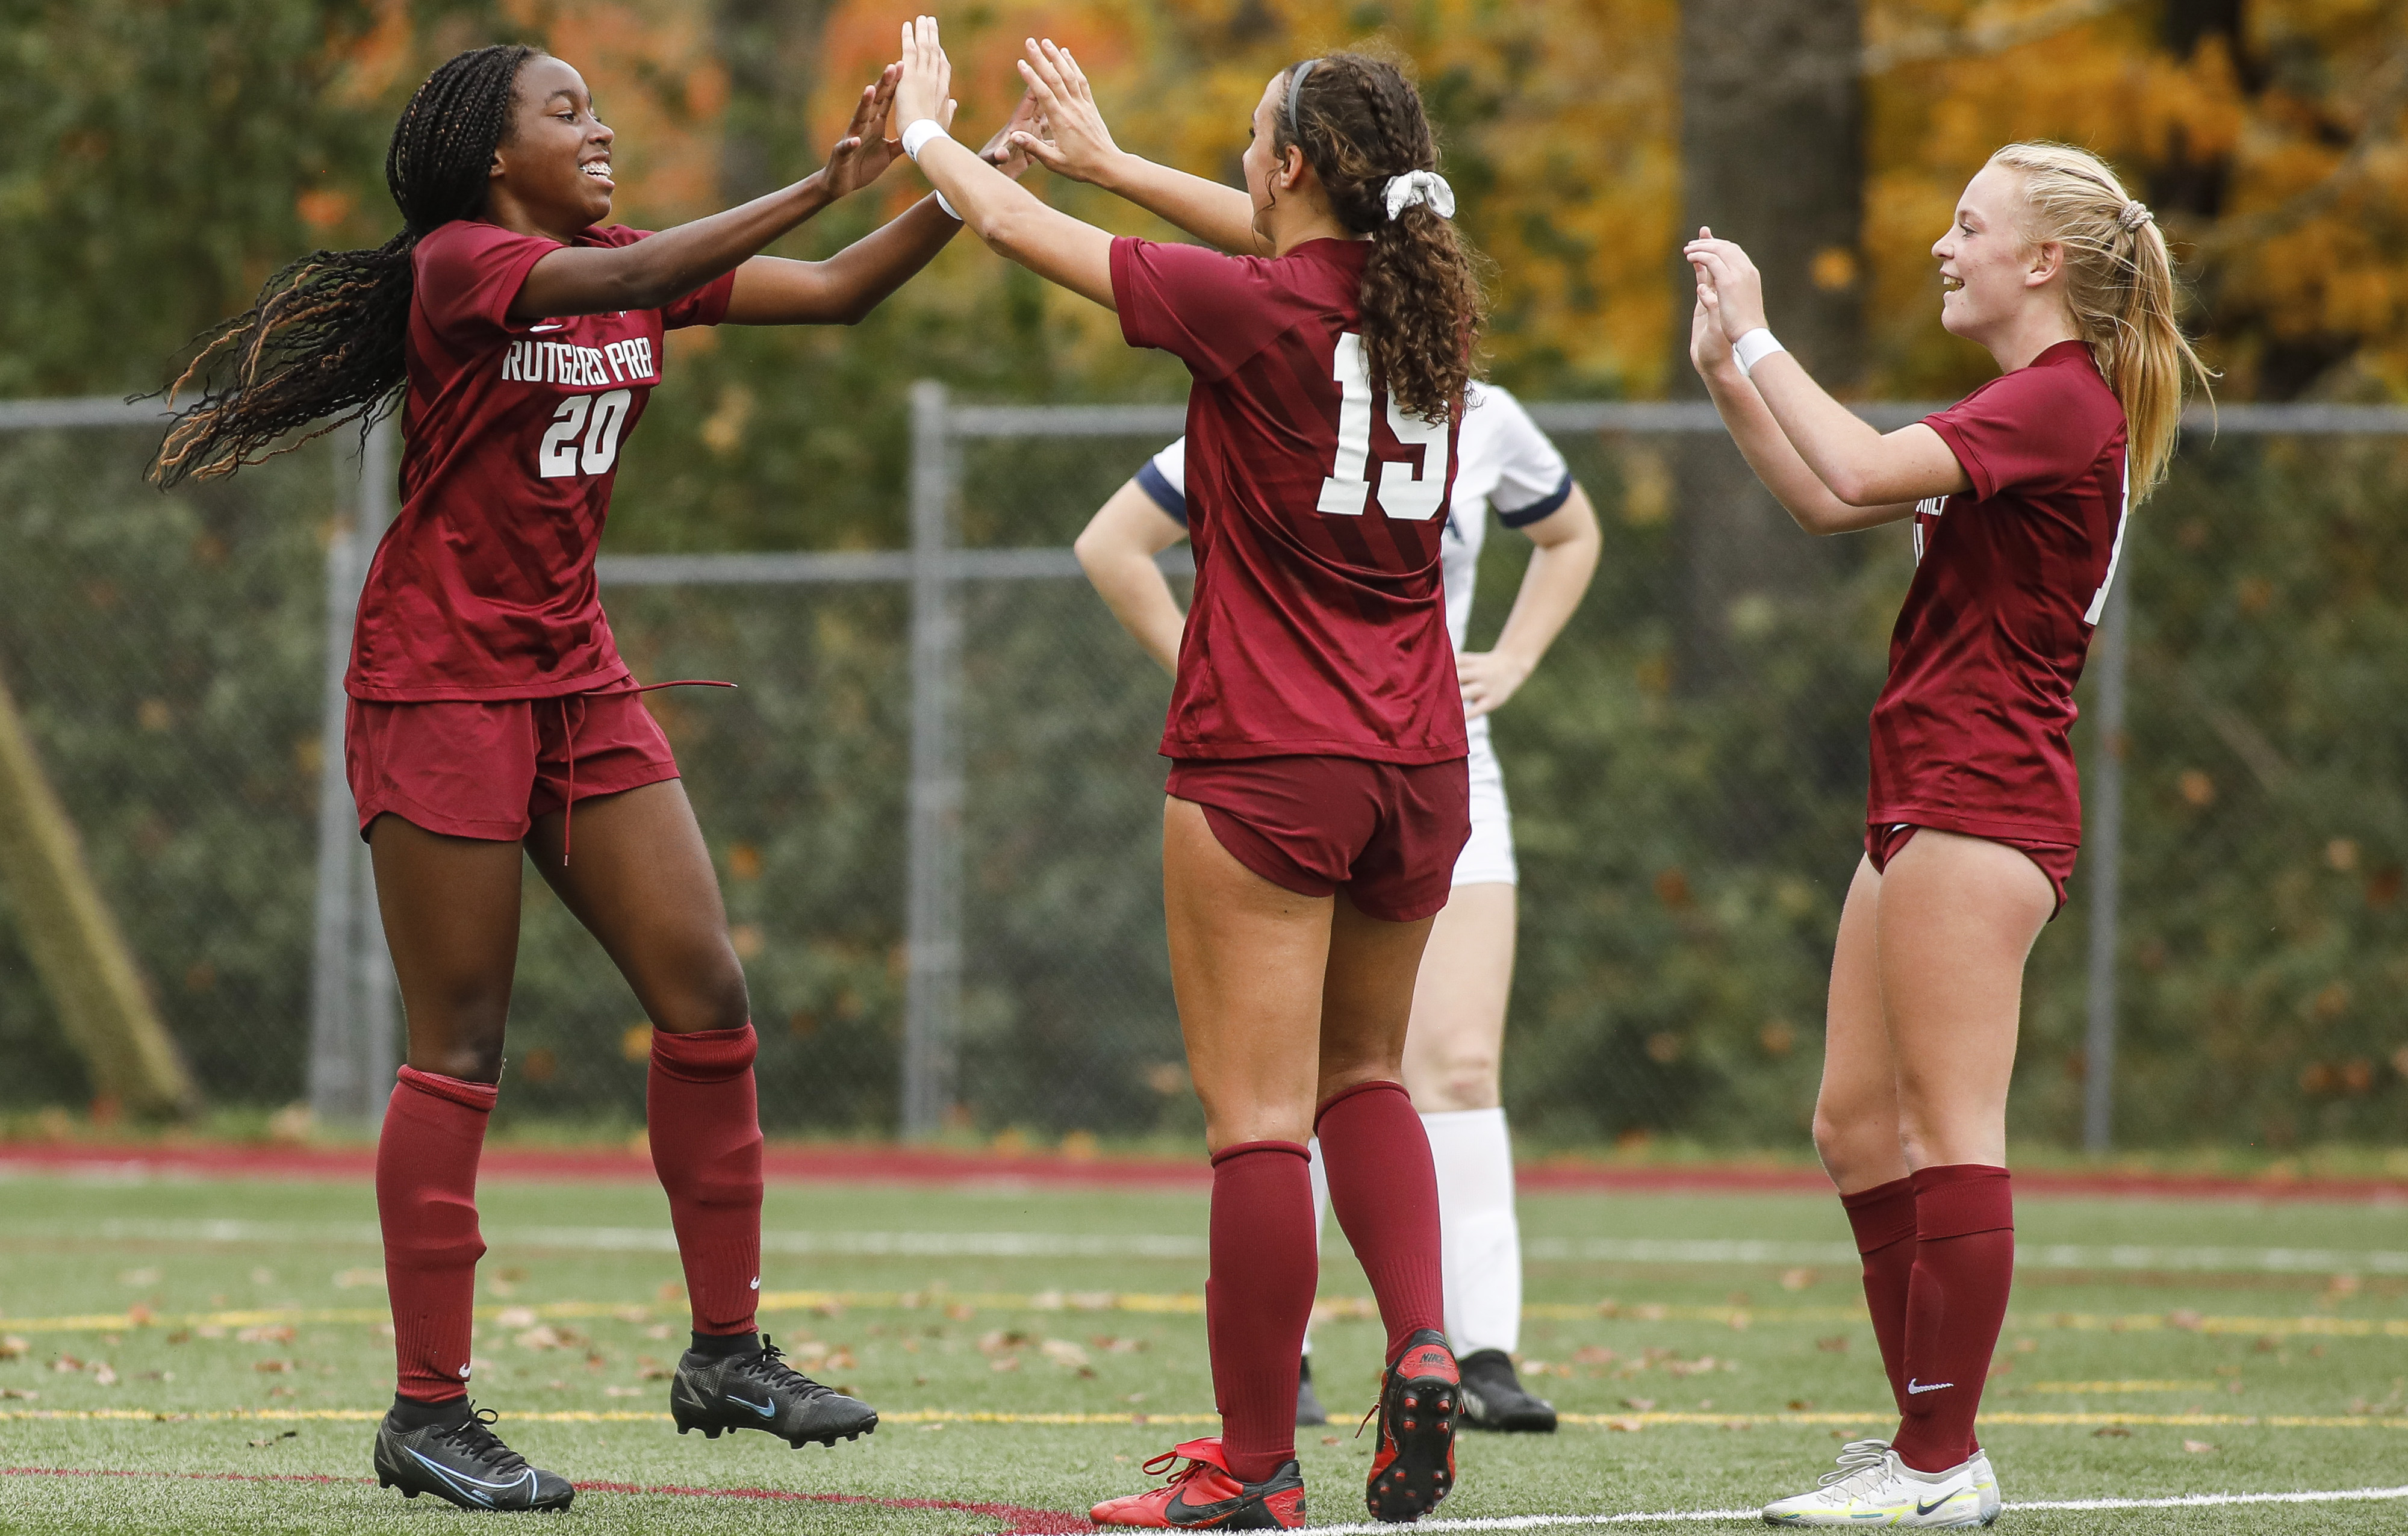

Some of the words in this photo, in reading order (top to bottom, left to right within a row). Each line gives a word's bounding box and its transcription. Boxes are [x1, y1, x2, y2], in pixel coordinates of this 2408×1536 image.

[502, 341, 610, 385] RUTGERS
[540, 389, 632, 478] 20
[1420, 1352, 1445, 1364] NIKE
